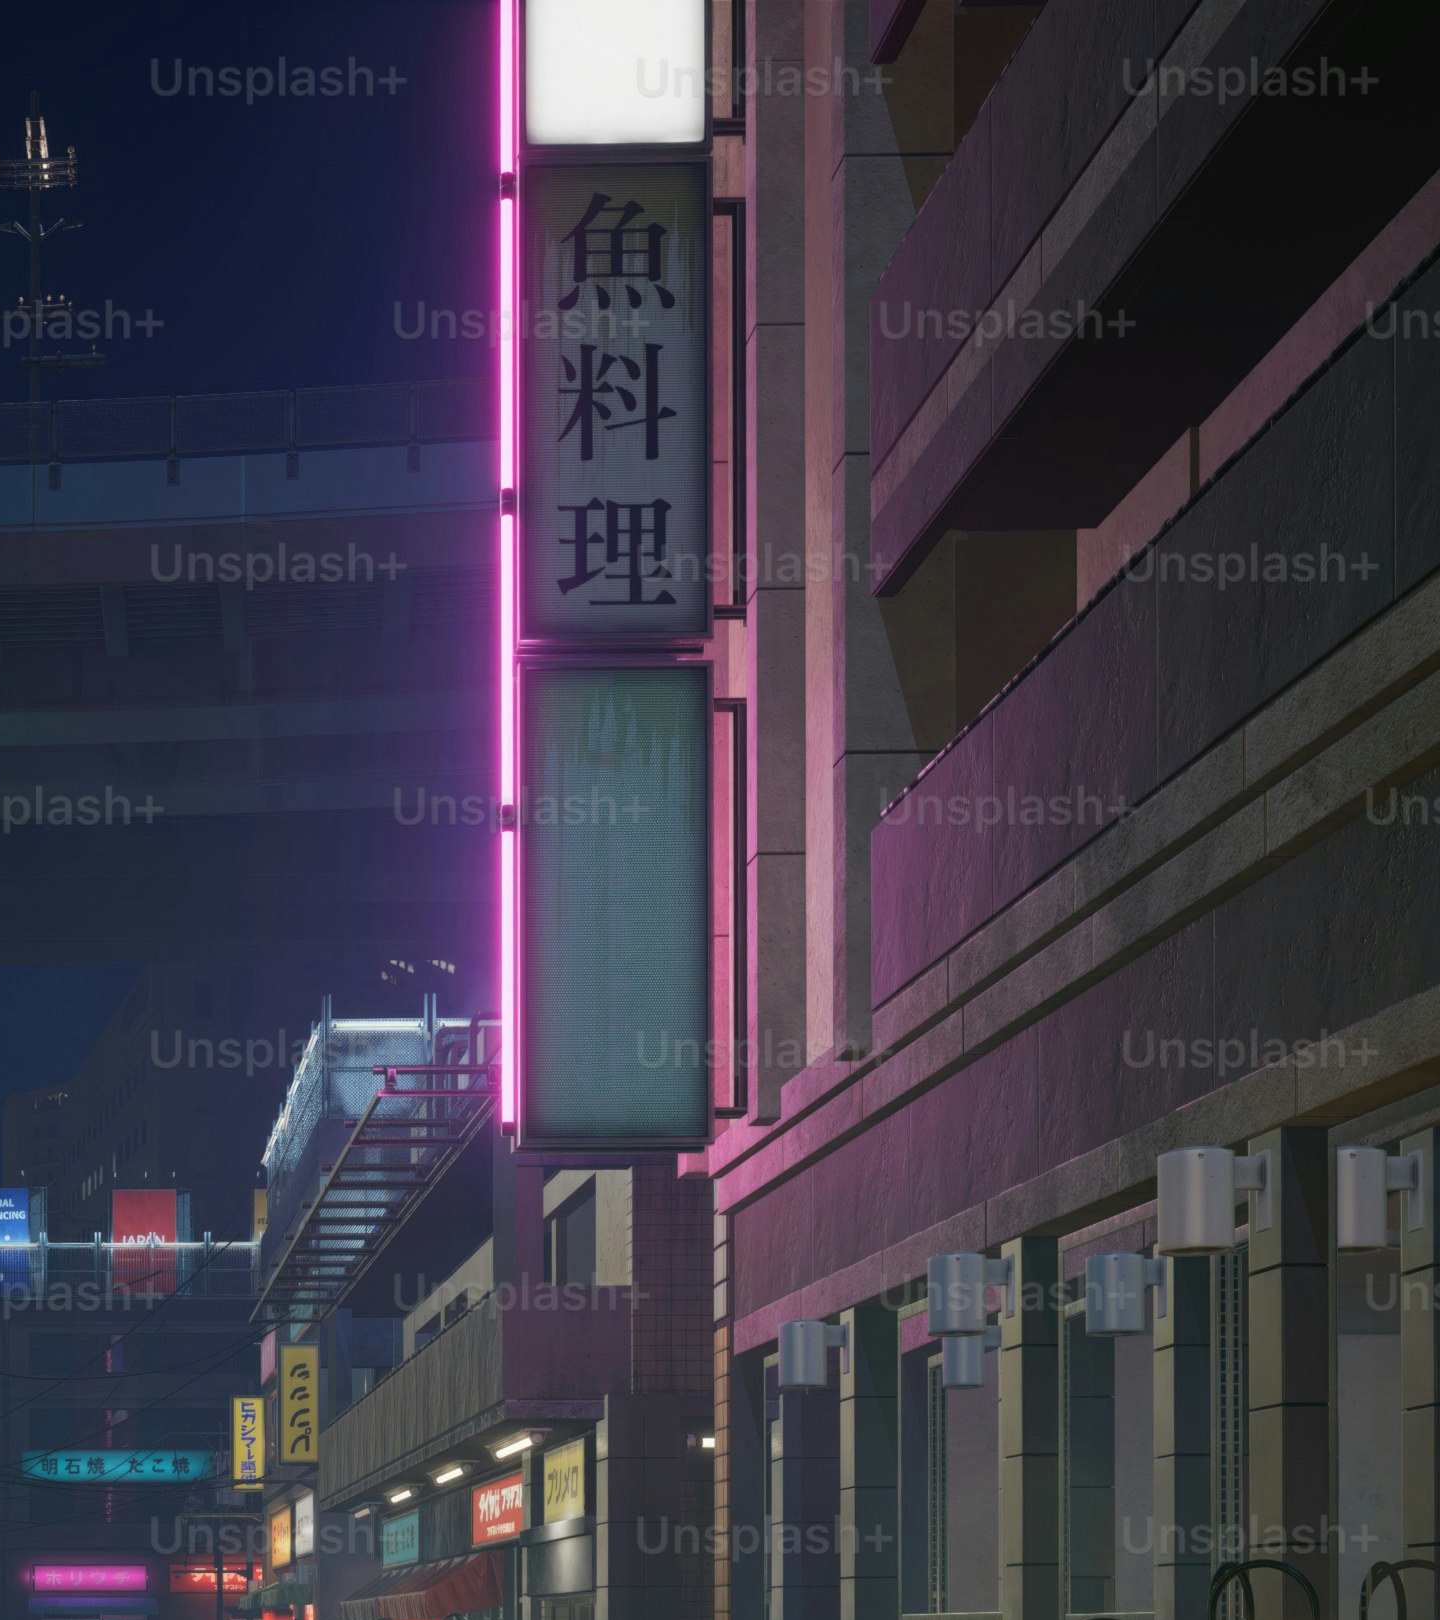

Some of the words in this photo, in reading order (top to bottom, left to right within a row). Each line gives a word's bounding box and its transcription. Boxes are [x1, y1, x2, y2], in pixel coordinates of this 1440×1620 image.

[557, 192, 677, 606] 魚料理
[41, 1456, 105, 1475] 明石焼
[129, 1456, 190, 1474] たこ焼
